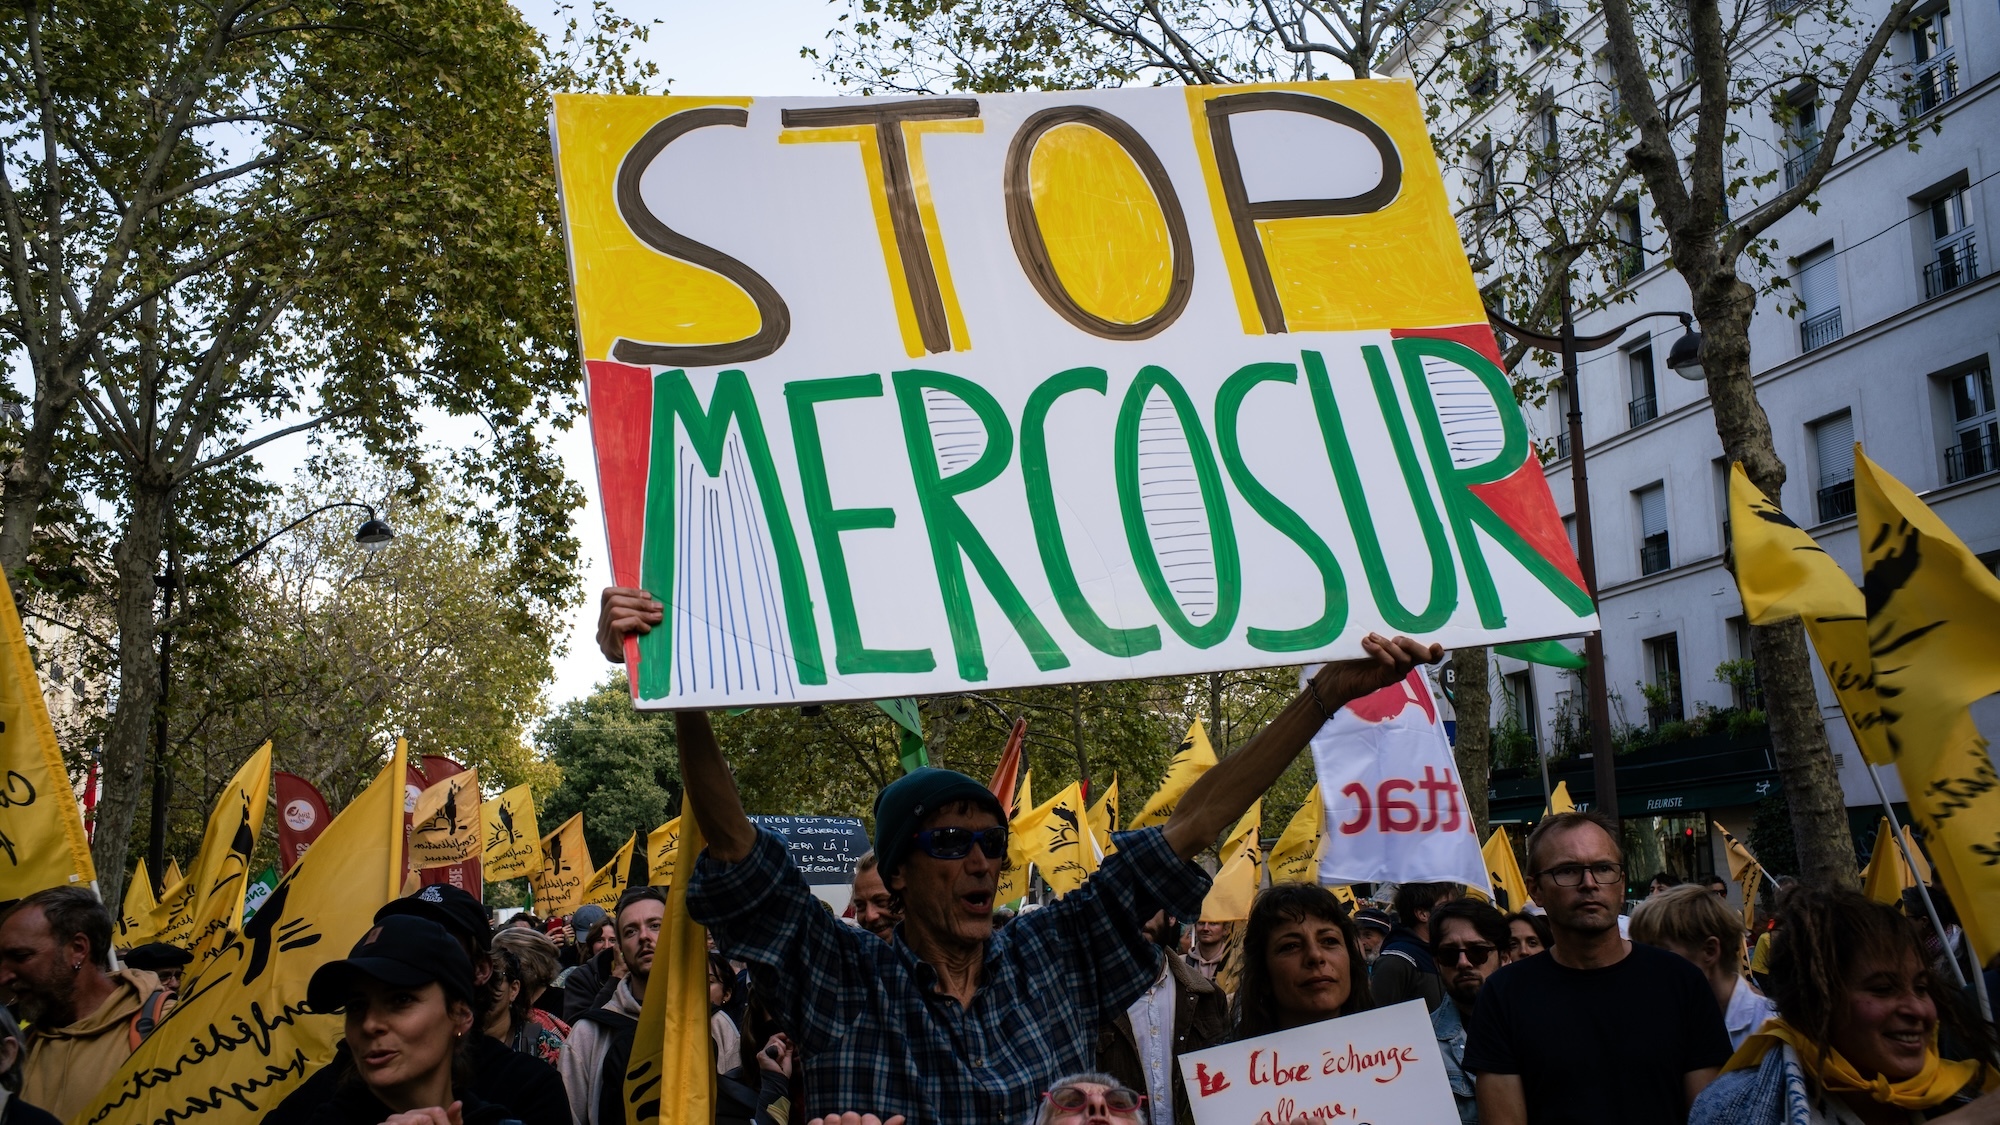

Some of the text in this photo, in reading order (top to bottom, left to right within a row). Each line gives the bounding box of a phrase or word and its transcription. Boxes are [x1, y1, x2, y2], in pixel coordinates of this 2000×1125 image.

[613, 91, 1402, 366] STOP
[638, 336, 1594, 701] MERCOSUR
[765, 816, 790, 824] N'EN
[1647, 797, 1684, 810] FLEURISTE
[1322, 1044, 1419, 1083] échange
